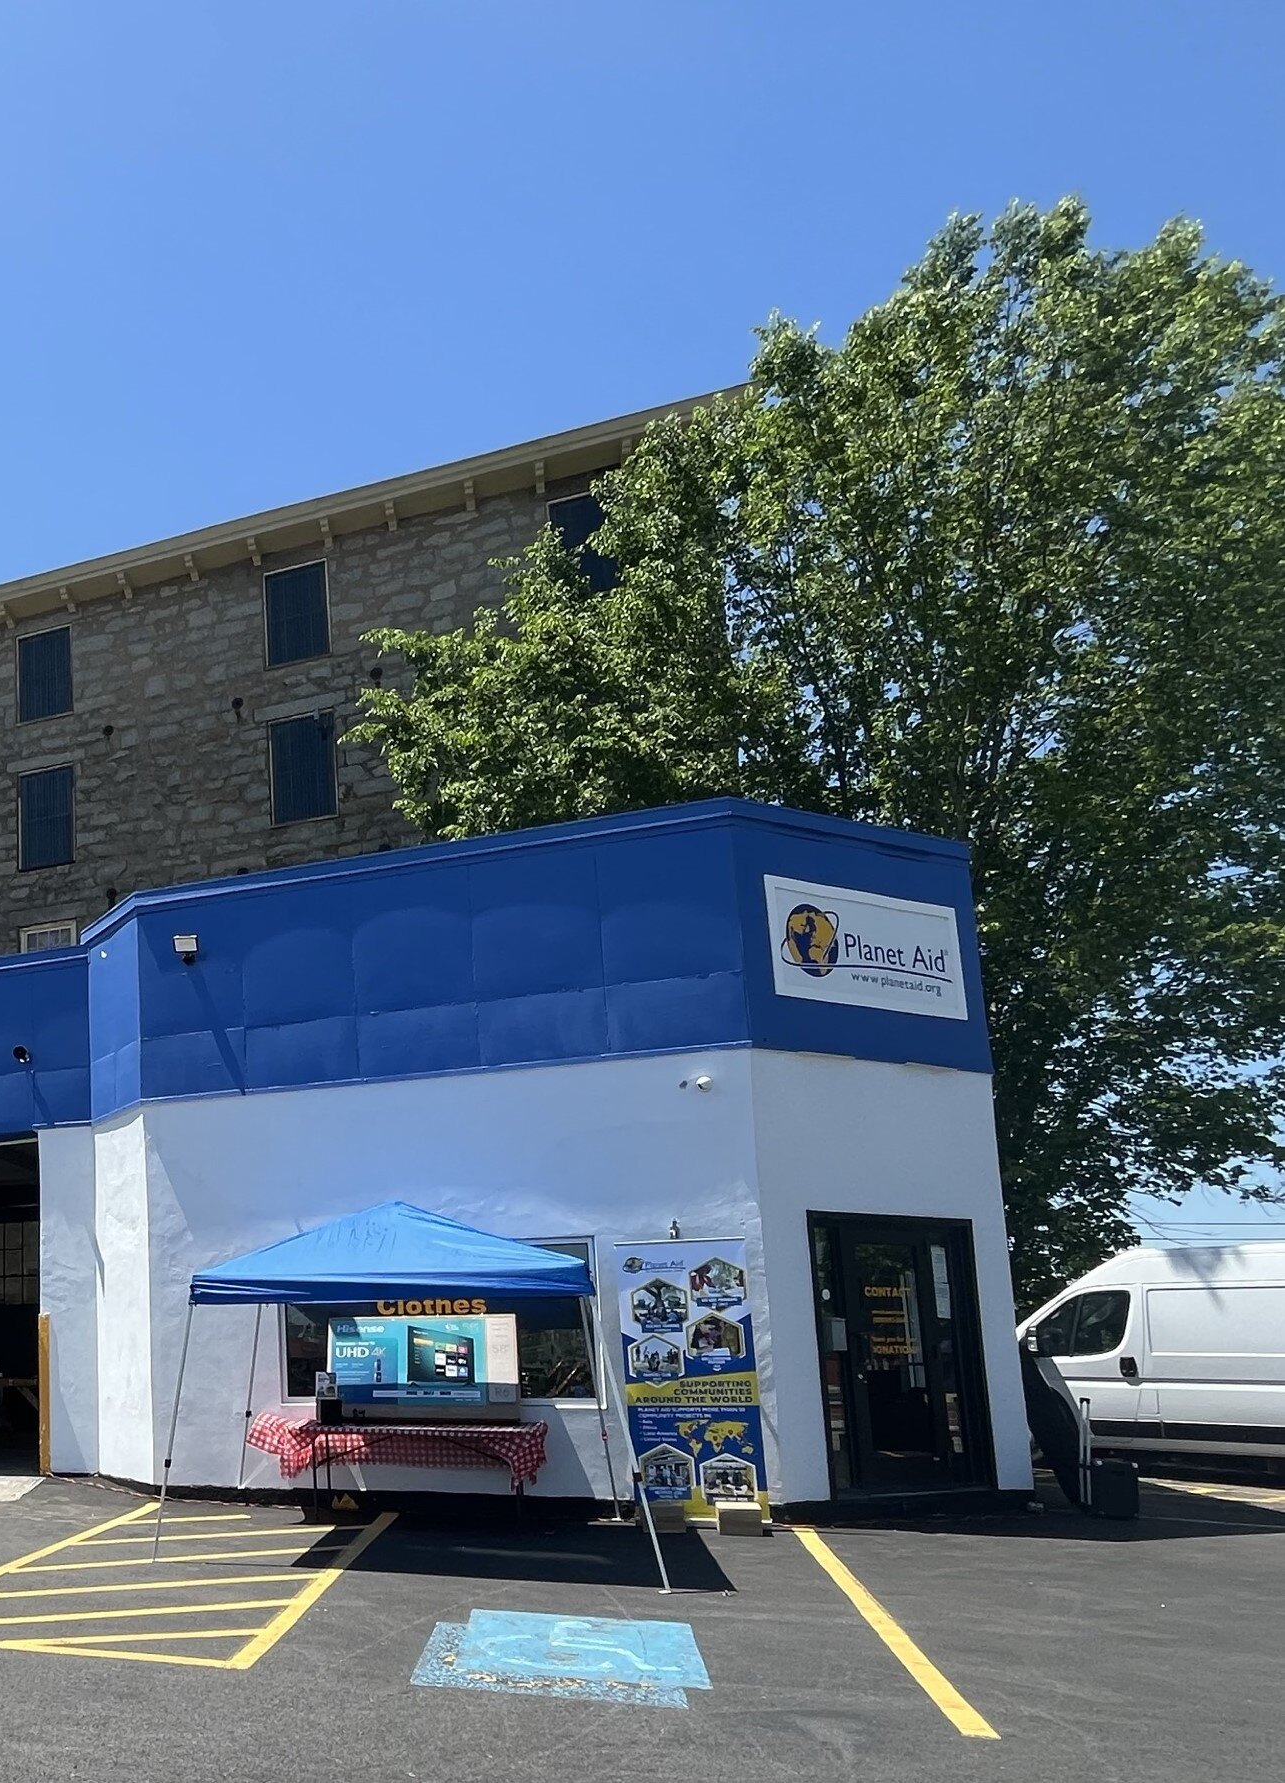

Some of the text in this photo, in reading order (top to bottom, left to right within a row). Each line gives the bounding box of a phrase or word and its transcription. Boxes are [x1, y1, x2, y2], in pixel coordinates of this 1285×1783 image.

[843, 933, 947, 973] Planet Aid
[864, 1286, 912, 1297] CONTACT
[376, 1298, 488, 1316] Clothes
[336, 1324, 385, 1334] Hisense
[335, 1346, 370, 1359] UHD
[679, 1380, 752, 1388] SUPPORTING
[673, 1388, 753, 1396] COMMUNITIES
[635, 1396, 753, 1404] AROUND THE WORLD
